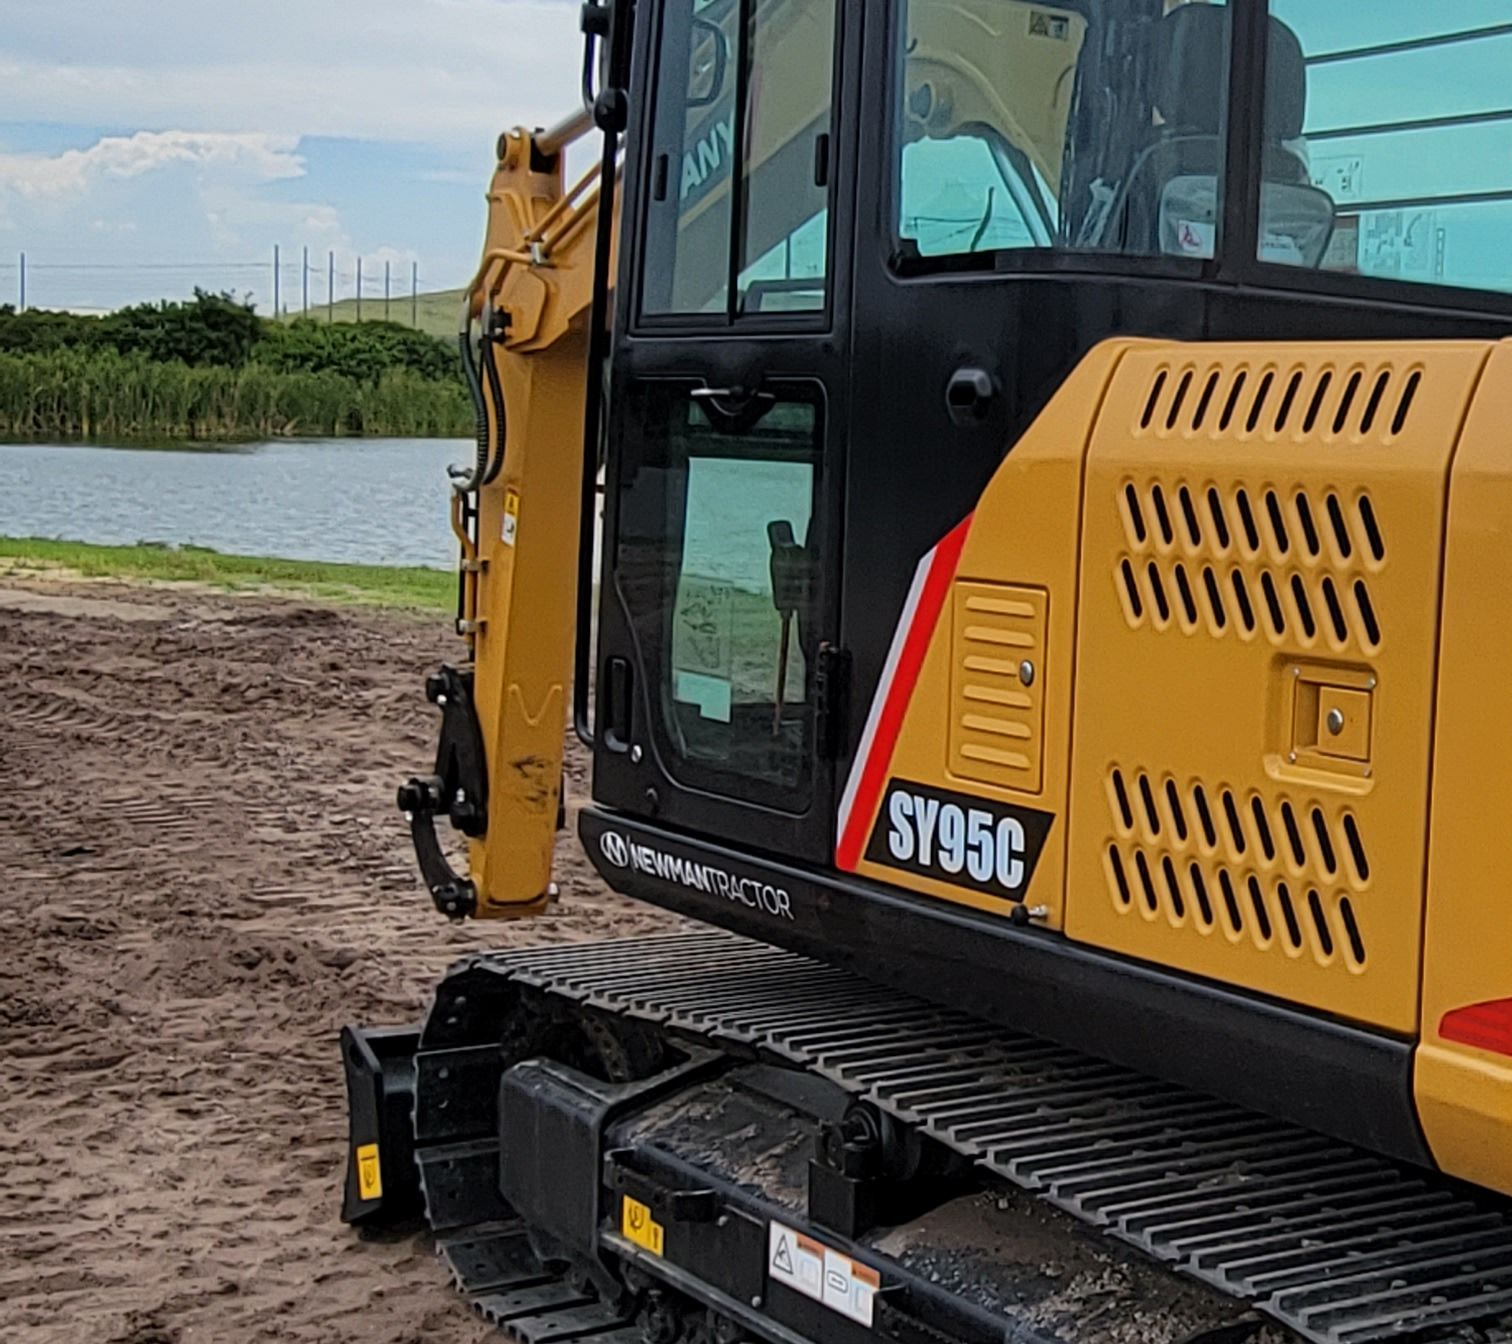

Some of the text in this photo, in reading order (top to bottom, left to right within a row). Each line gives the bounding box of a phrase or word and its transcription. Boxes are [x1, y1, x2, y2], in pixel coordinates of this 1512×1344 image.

[680, 111, 735, 200] ANY
[629, 842, 795, 920] NEWMANTRACTOR
[888, 790, 1025, 889] SY95C
